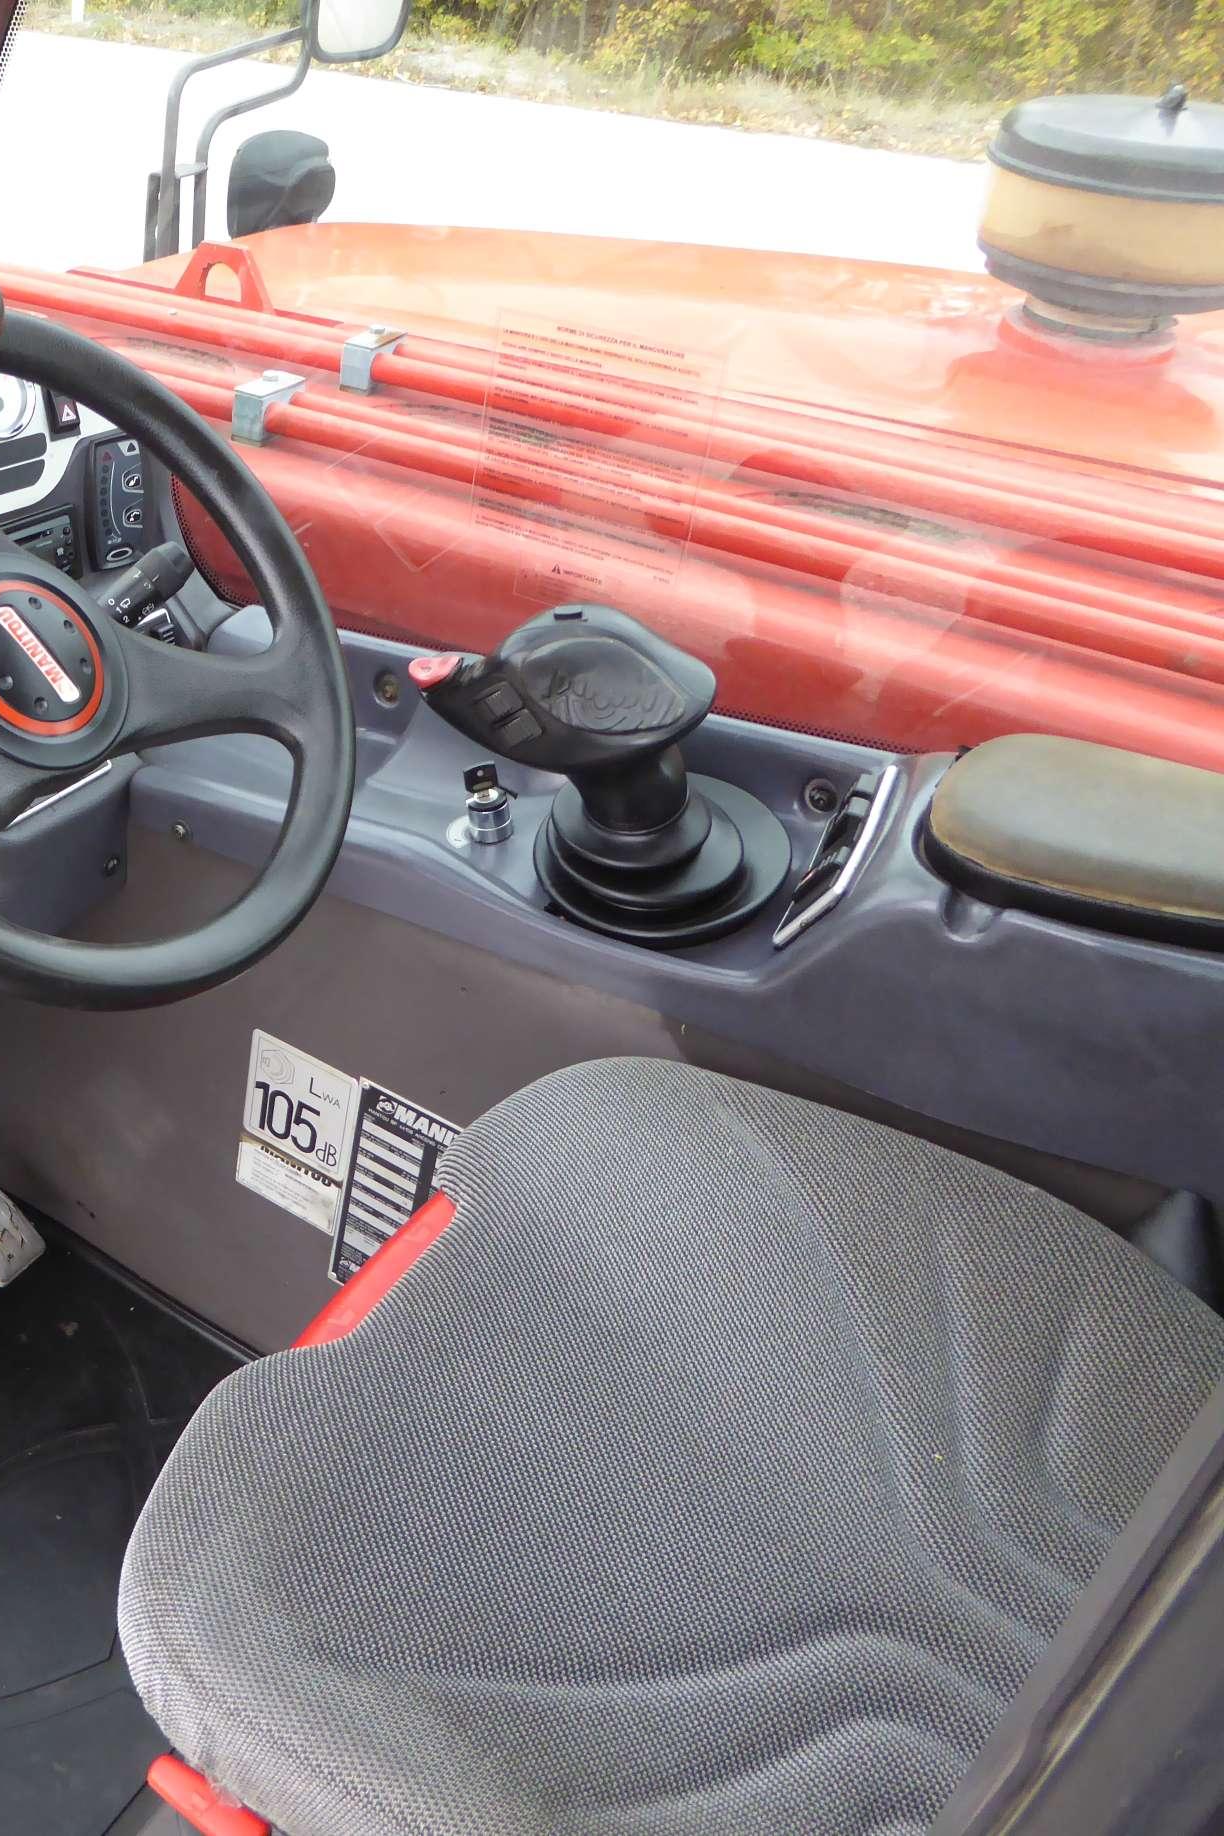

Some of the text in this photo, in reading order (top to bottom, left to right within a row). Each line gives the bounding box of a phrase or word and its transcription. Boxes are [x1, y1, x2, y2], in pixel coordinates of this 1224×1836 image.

[255, 1081, 321, 1153] 105
[316, 1142, 337, 1166] dB
[394, 1104, 459, 1148] MANI
